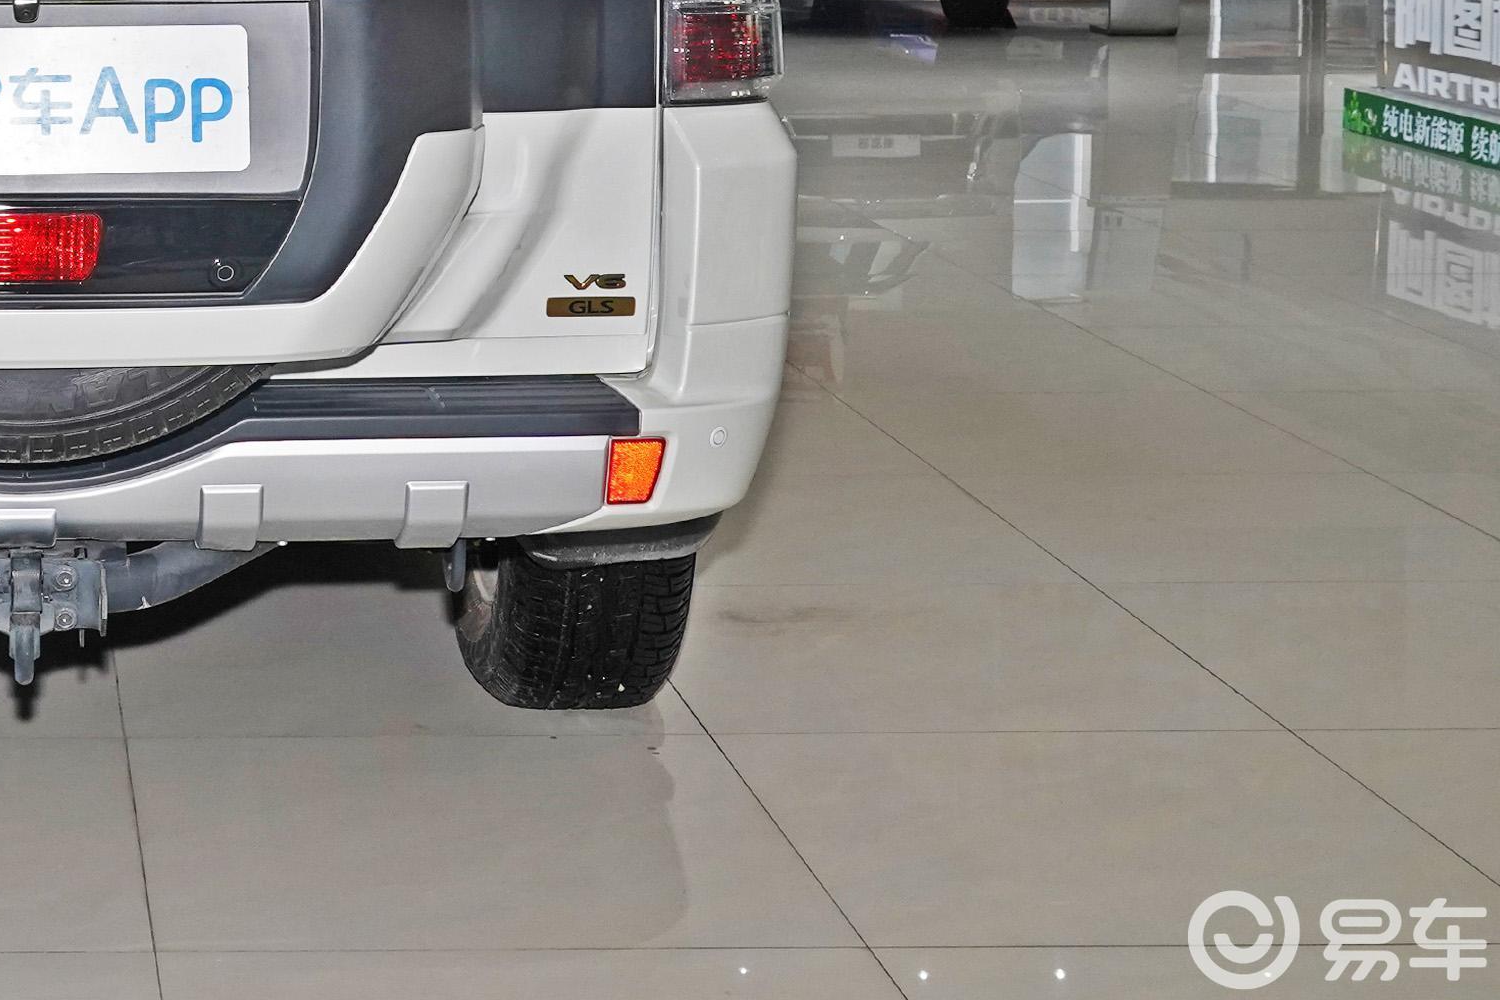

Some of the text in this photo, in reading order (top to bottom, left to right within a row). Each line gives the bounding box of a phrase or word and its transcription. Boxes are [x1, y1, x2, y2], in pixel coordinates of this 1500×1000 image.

[1382, 104, 1465, 154] 纯电新能源
[563, 274, 626, 290] V6
[569, 301, 614, 313] GLS
